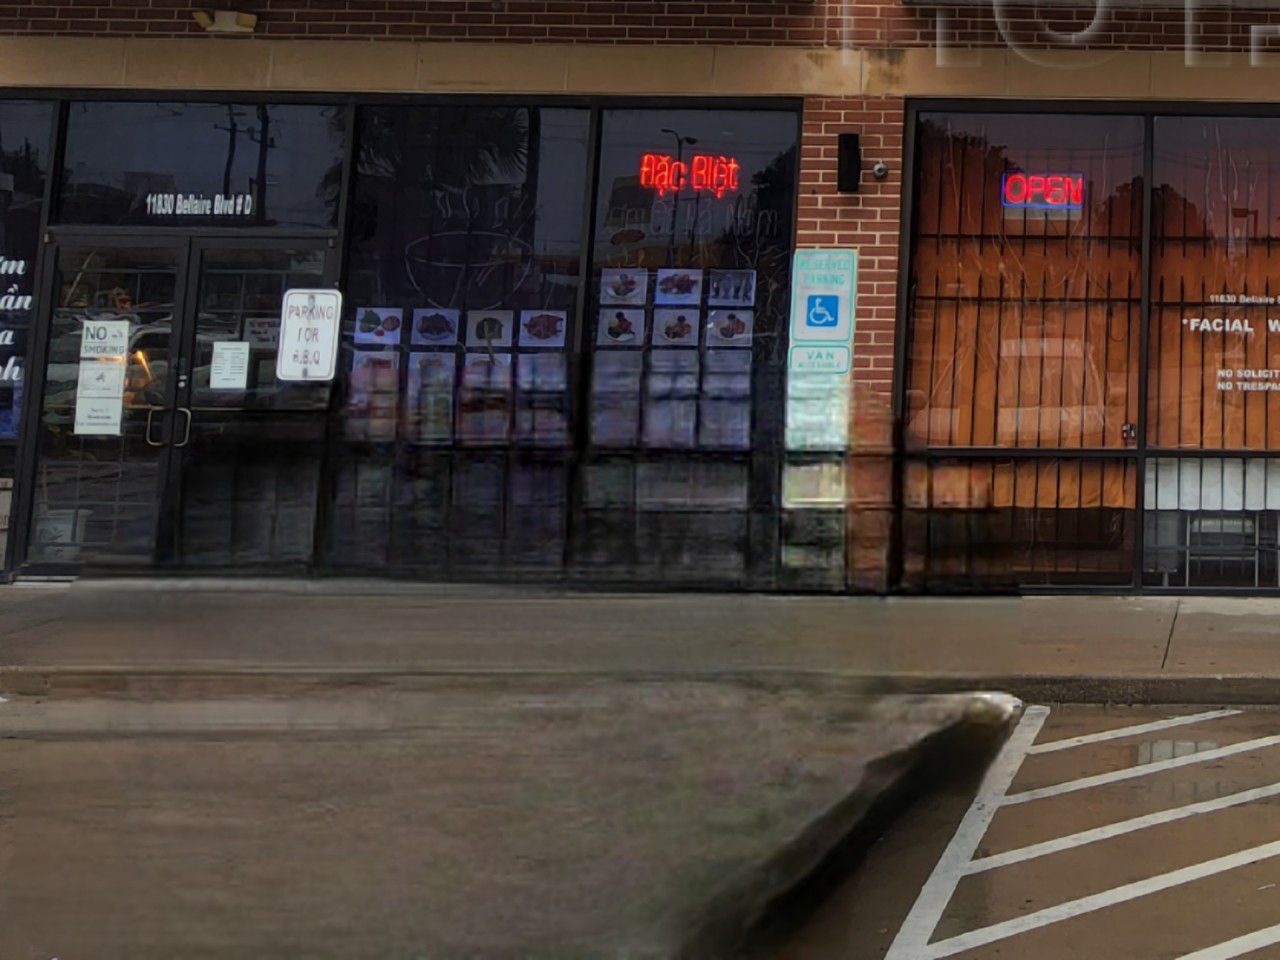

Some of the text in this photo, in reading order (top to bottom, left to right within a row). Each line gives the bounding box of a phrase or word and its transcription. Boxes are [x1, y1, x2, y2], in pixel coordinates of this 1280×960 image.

[1005, 173, 1083, 205] OPEN
[85, 326, 107, 341] NO
[807, 351, 835, 360] VAN
[1217, 369, 1233, 378] NO
[1217, 381, 1233, 391] NO
